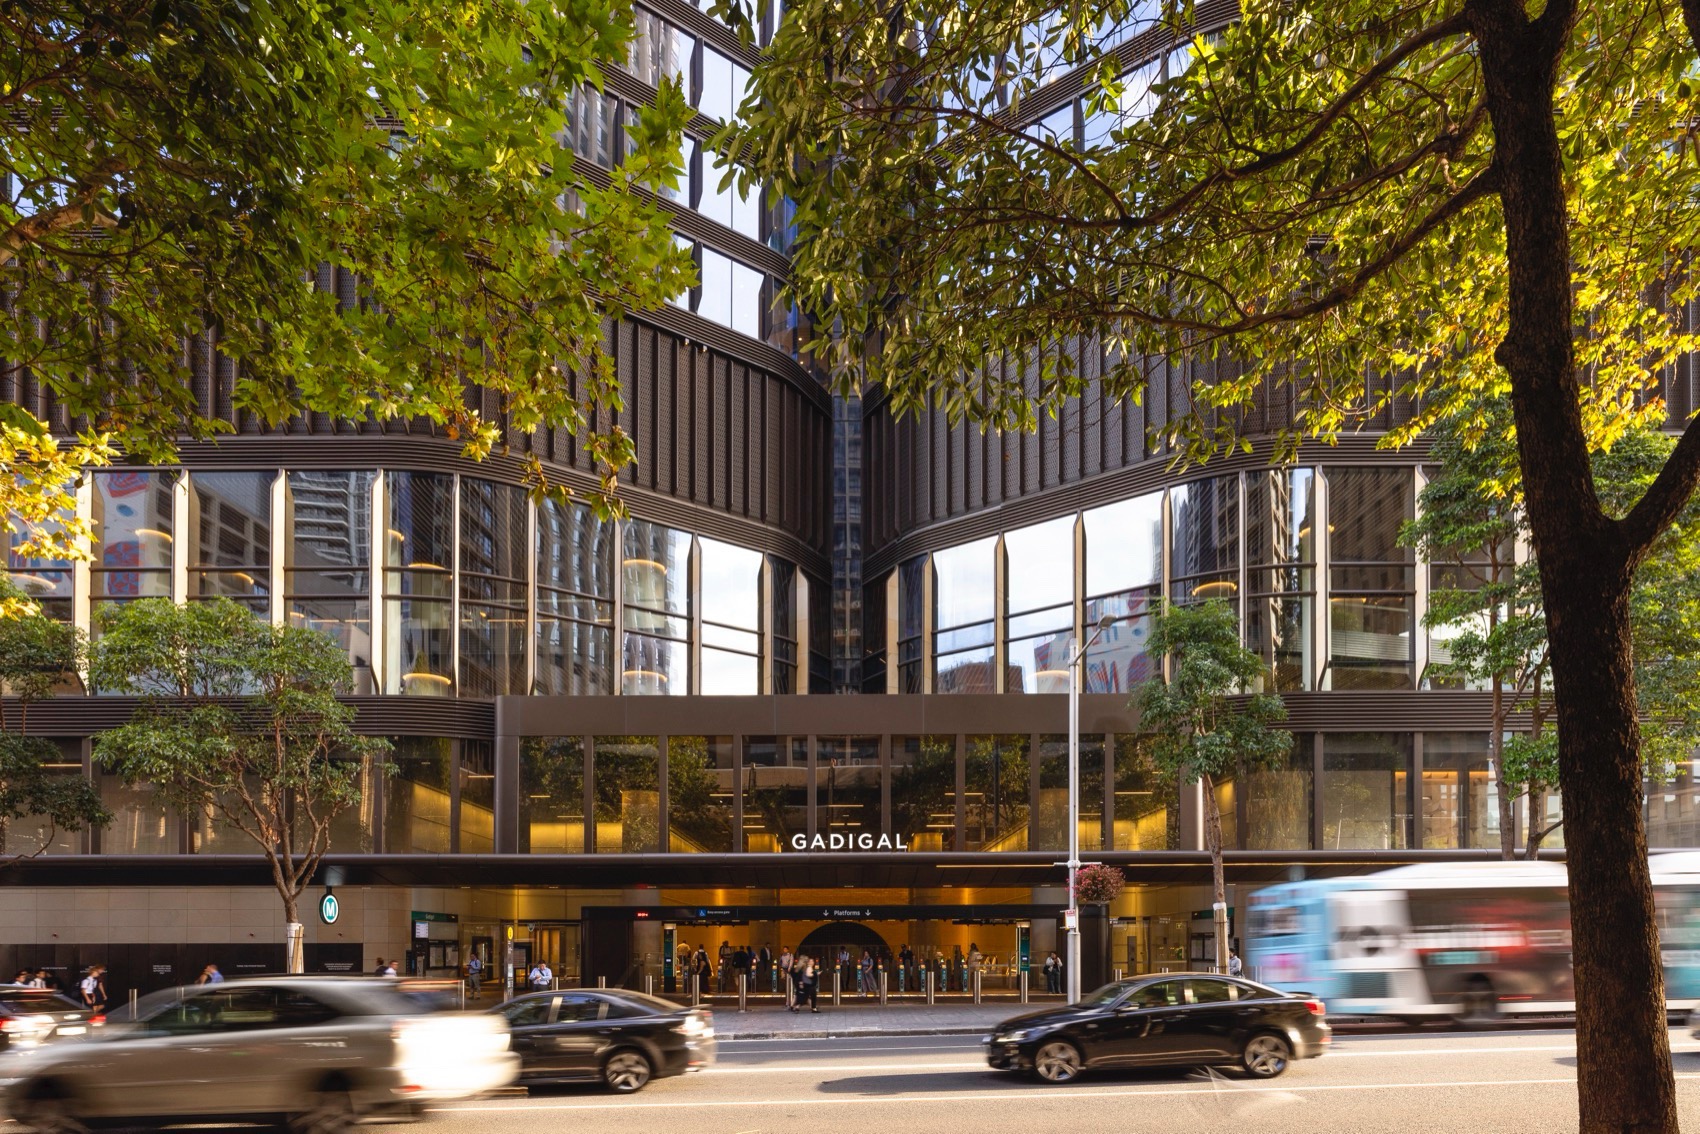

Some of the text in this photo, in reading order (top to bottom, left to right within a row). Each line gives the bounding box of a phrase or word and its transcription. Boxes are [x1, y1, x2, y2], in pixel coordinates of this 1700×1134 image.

[791, 833, 908, 850] GADIGAL
[326, 901, 335, 917] M
[833, 909, 861, 917] Platforms
